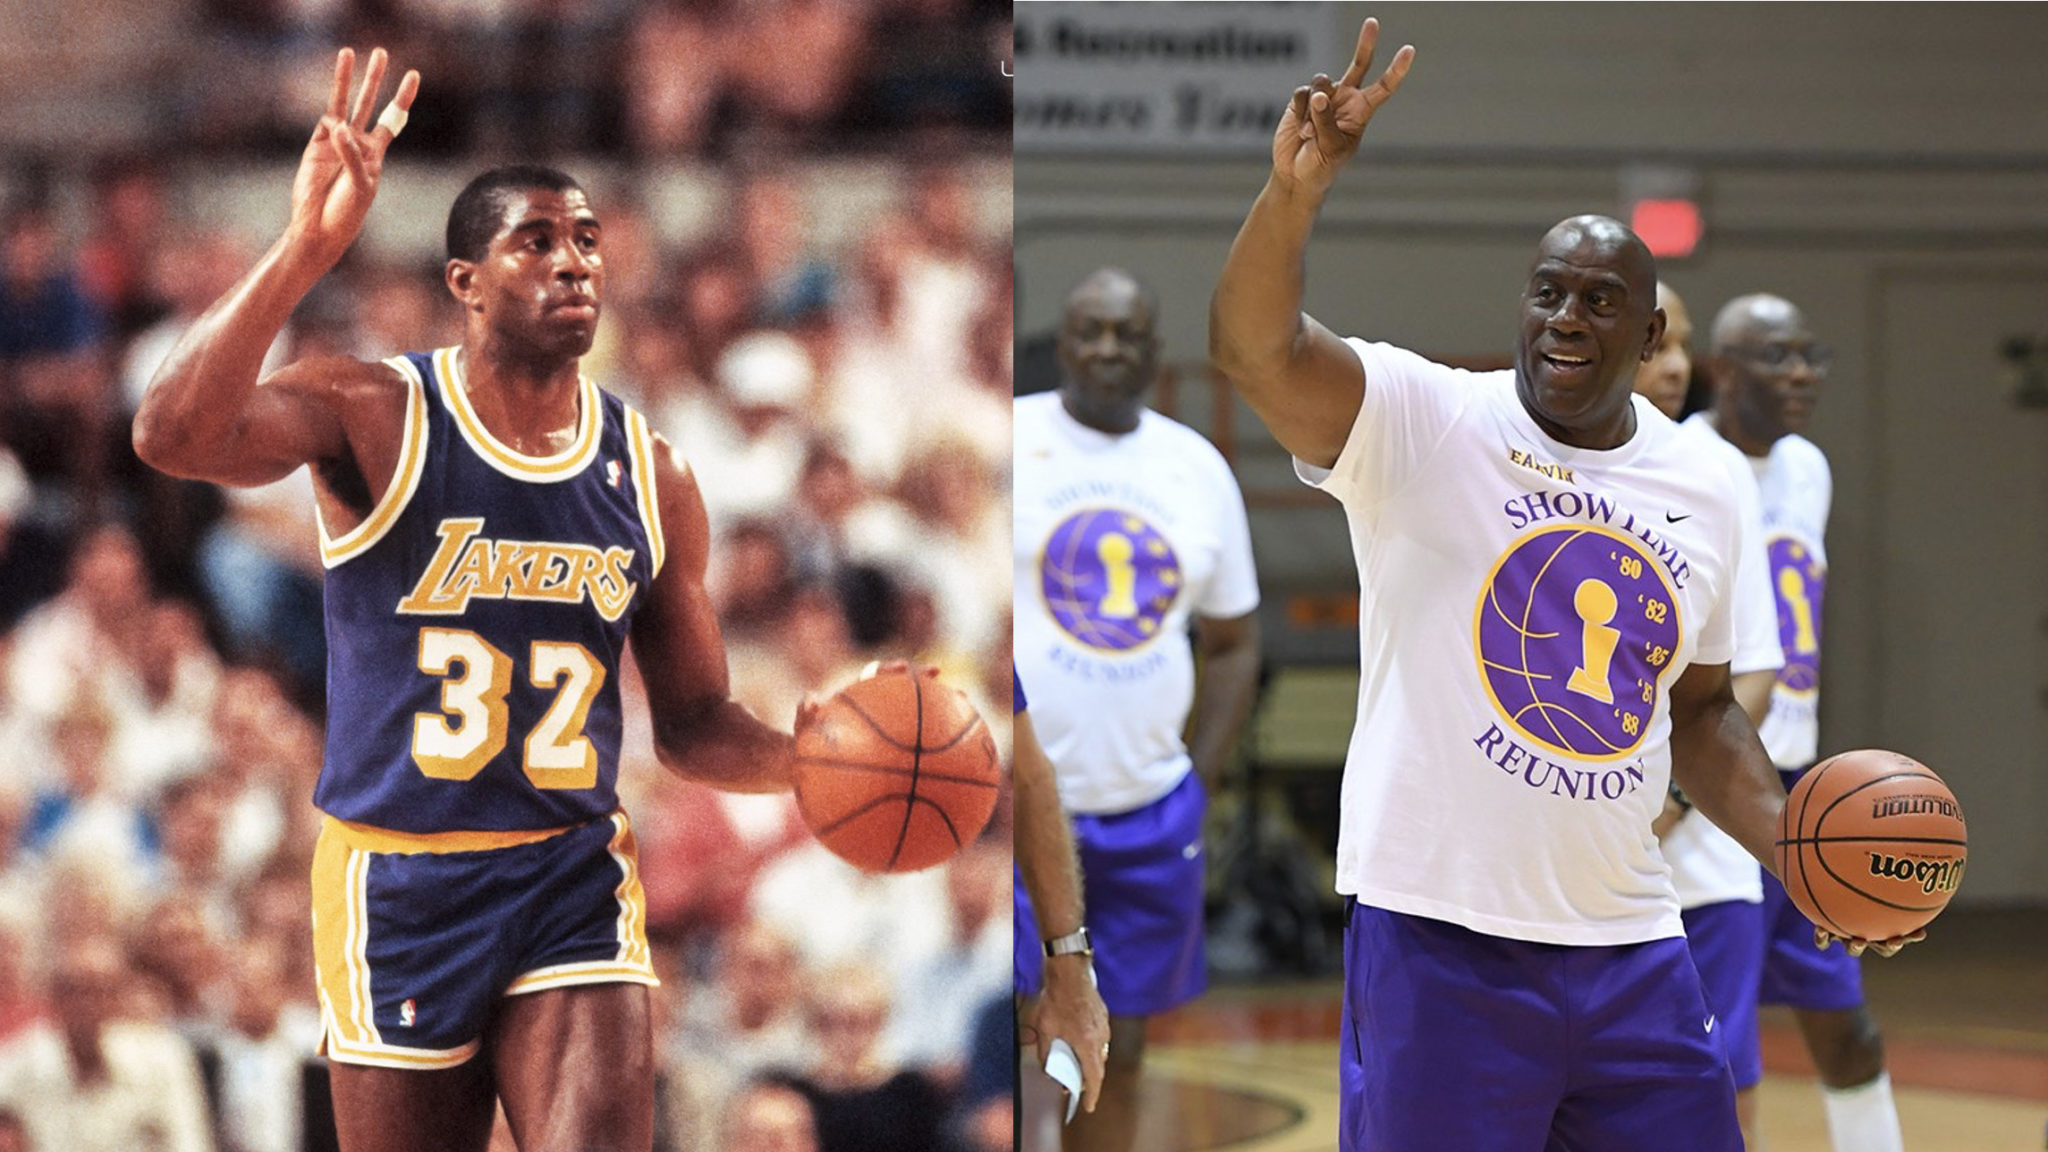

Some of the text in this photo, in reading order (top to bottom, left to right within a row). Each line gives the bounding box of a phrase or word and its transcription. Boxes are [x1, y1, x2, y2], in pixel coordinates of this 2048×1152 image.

[396, 517, 637, 622] LAKERS
[412, 627, 607, 790] 32
[1473, 721, 1645, 801] REUNION
